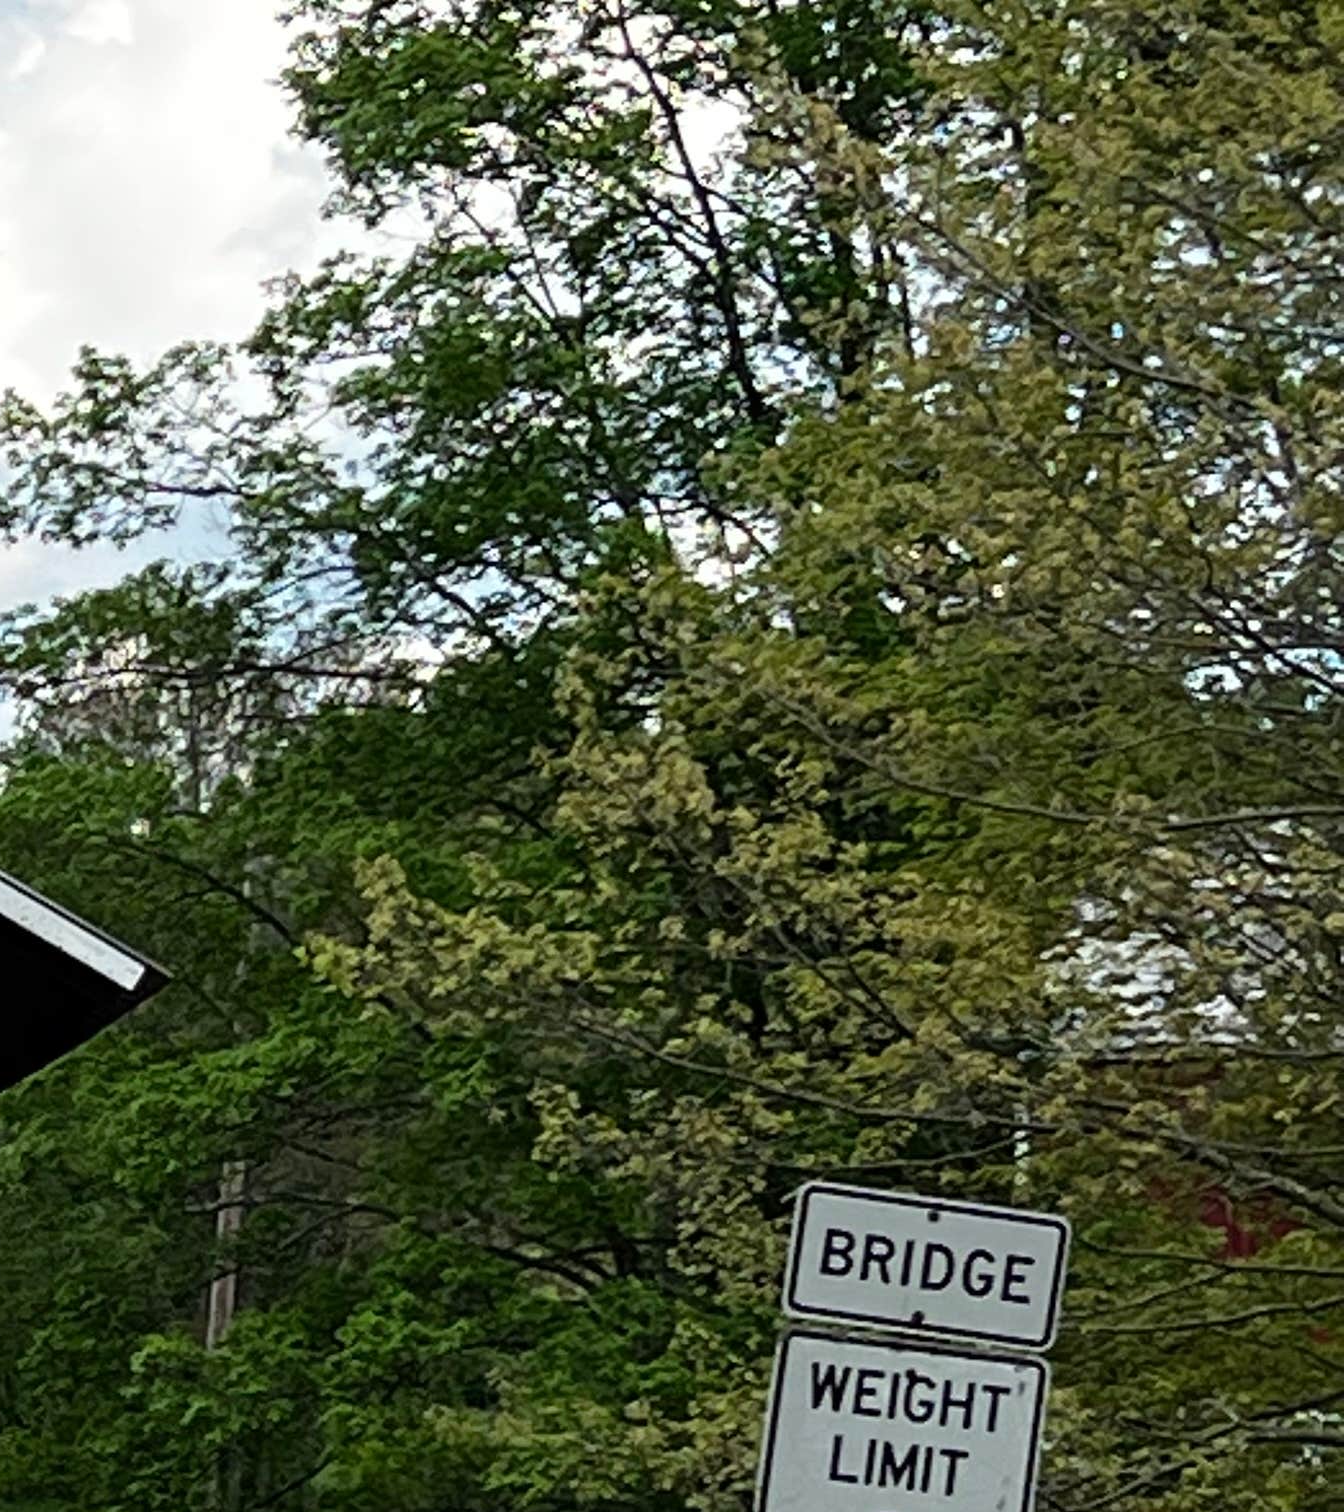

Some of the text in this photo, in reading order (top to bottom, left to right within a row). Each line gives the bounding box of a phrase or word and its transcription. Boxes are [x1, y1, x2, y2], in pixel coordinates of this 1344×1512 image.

[819, 1228, 1036, 1305] BRIDGE
[811, 1361, 1011, 1433] WEIGHT
[828, 1435, 969, 1497] LIMIT
